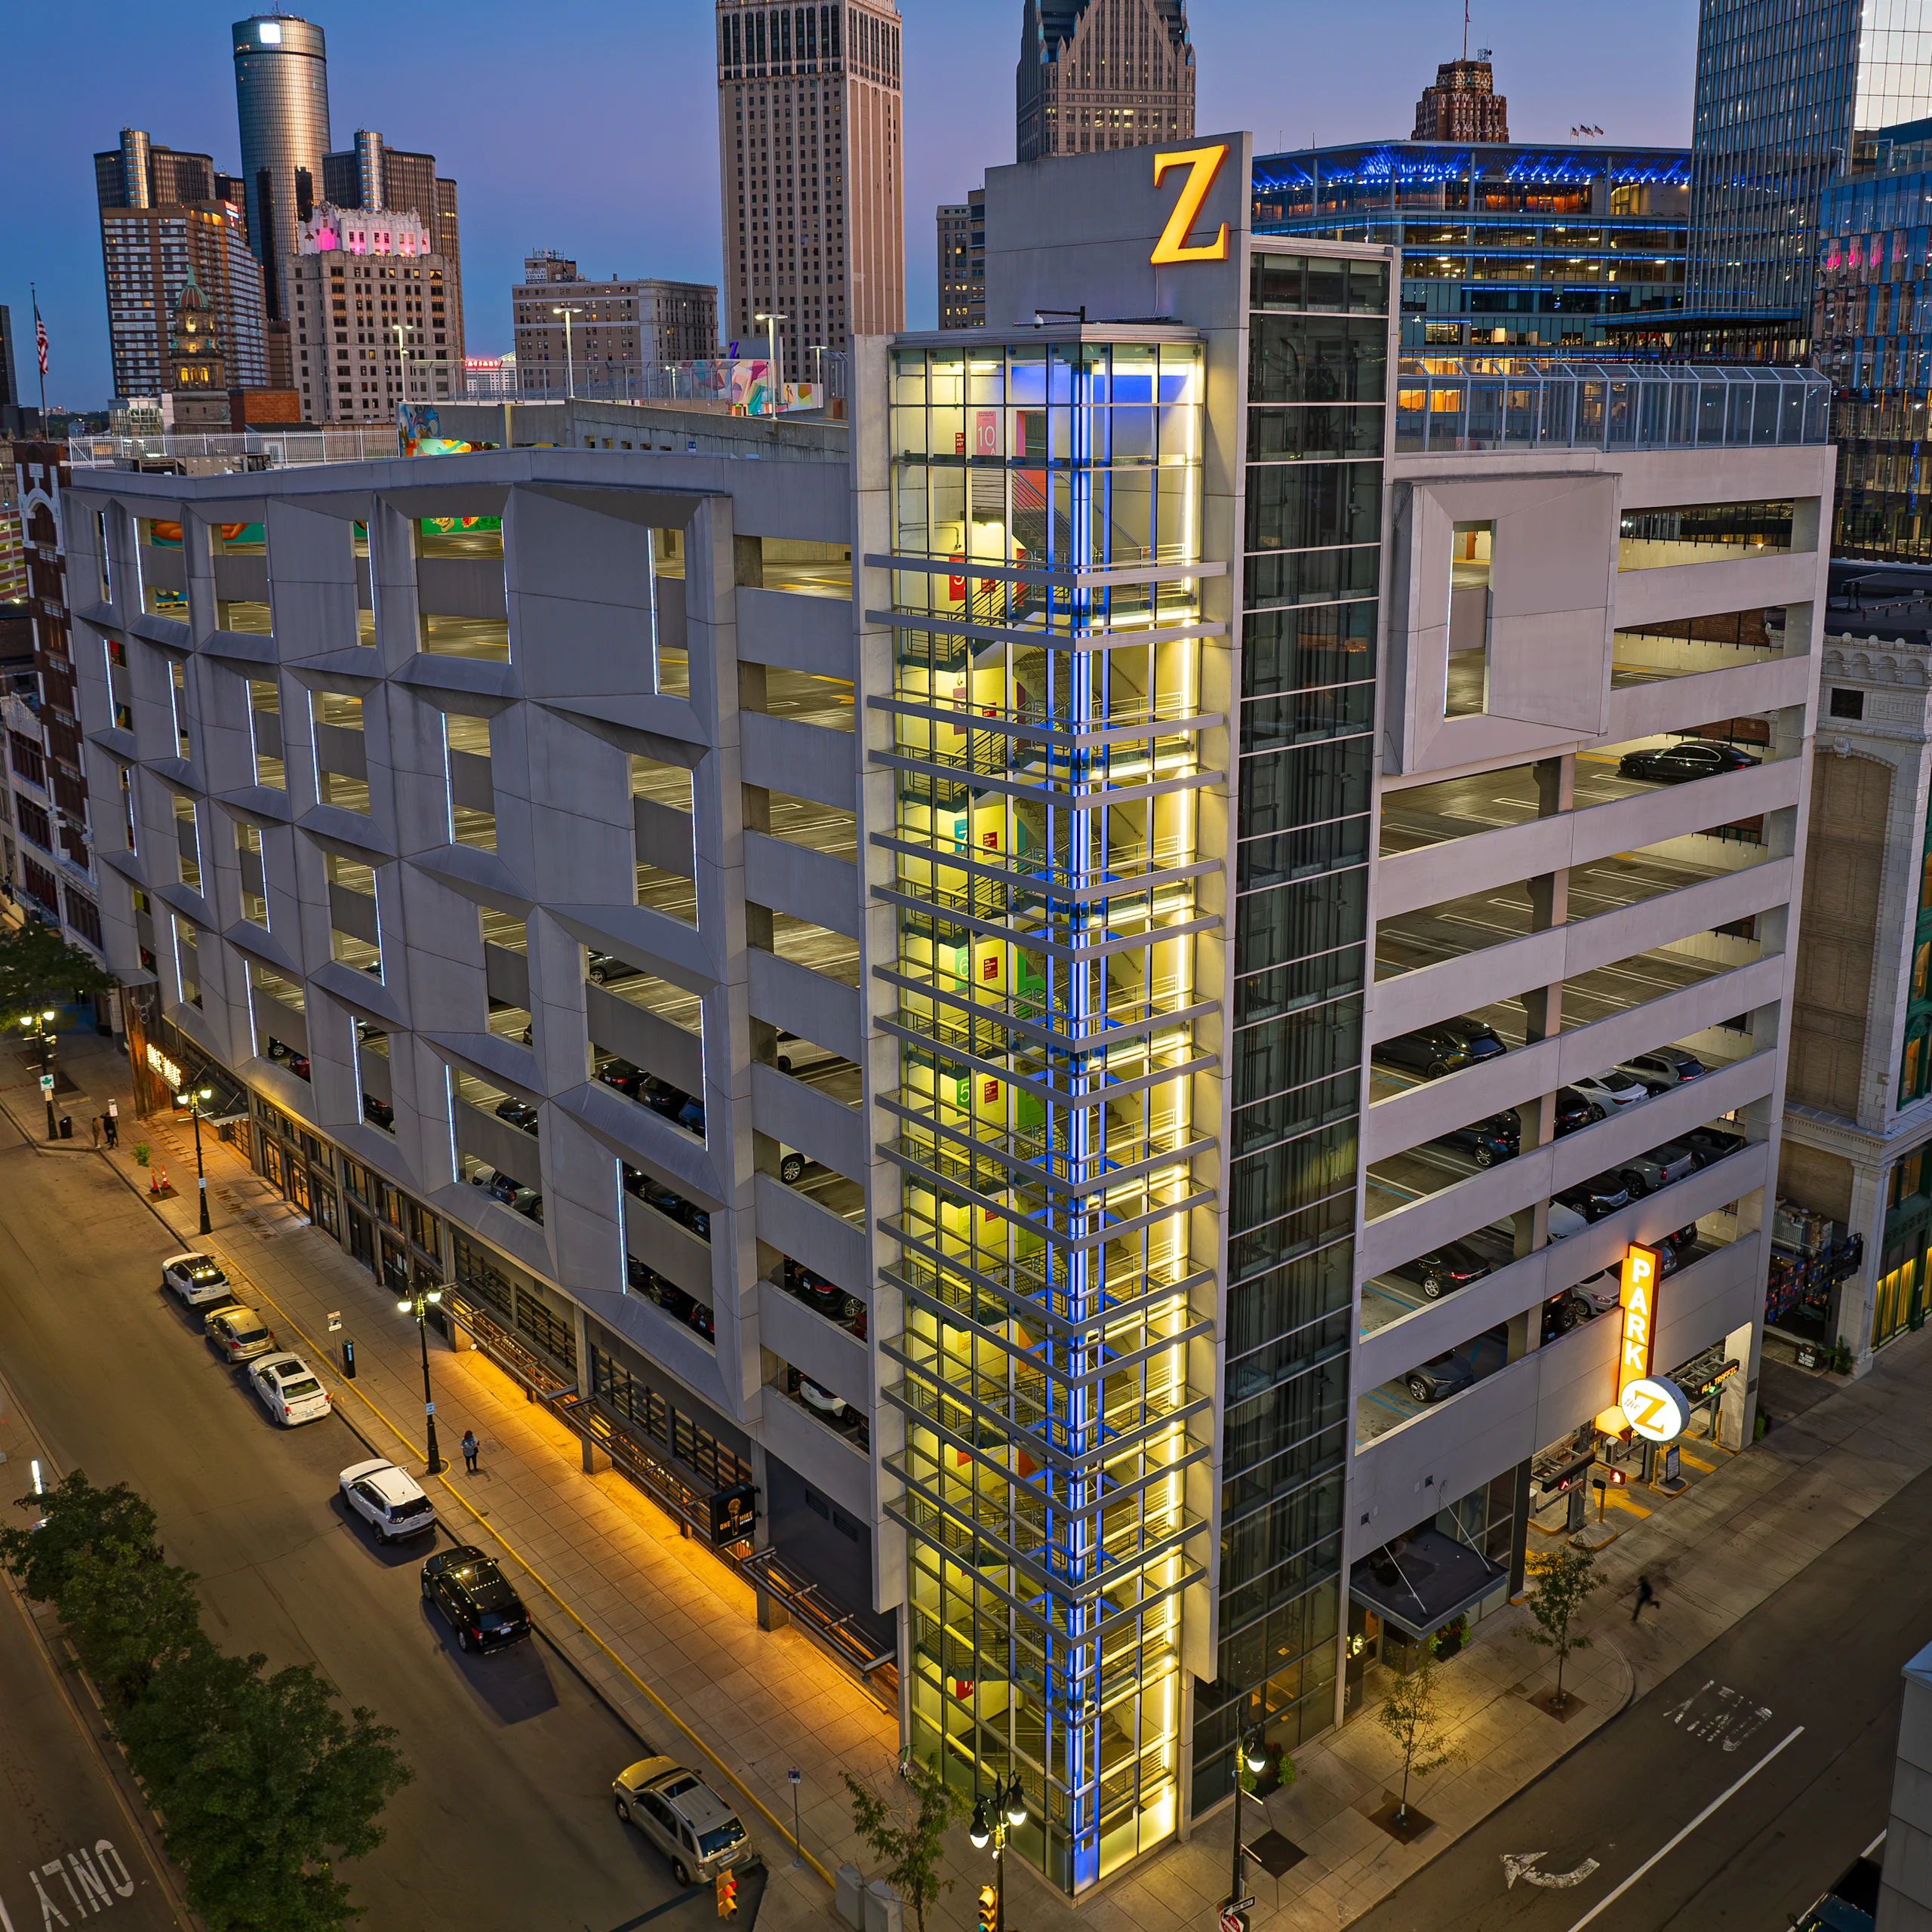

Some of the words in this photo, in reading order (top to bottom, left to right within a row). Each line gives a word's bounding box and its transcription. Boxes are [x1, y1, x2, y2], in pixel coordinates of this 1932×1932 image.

[1150, 144, 1229, 265] Z
[729, 341, 740, 359] Z
[977, 425, 995, 447] 10
[959, 956, 969, 977] 6
[960, 1081, 970, 1103] 5
[1624, 1257, 1651, 1371] PARK
[1701, 1381, 1713, 1394] ALL
[1714, 1365, 1738, 1386] TRAFFIC
[1624, 1398, 1640, 1411] the
[1634, 1389, 1667, 1435] Z
[719, 1520, 731, 1531] ONE
[739, 1510, 753, 1521] MIKE
[29, 1839, 134, 1932] ONLY
